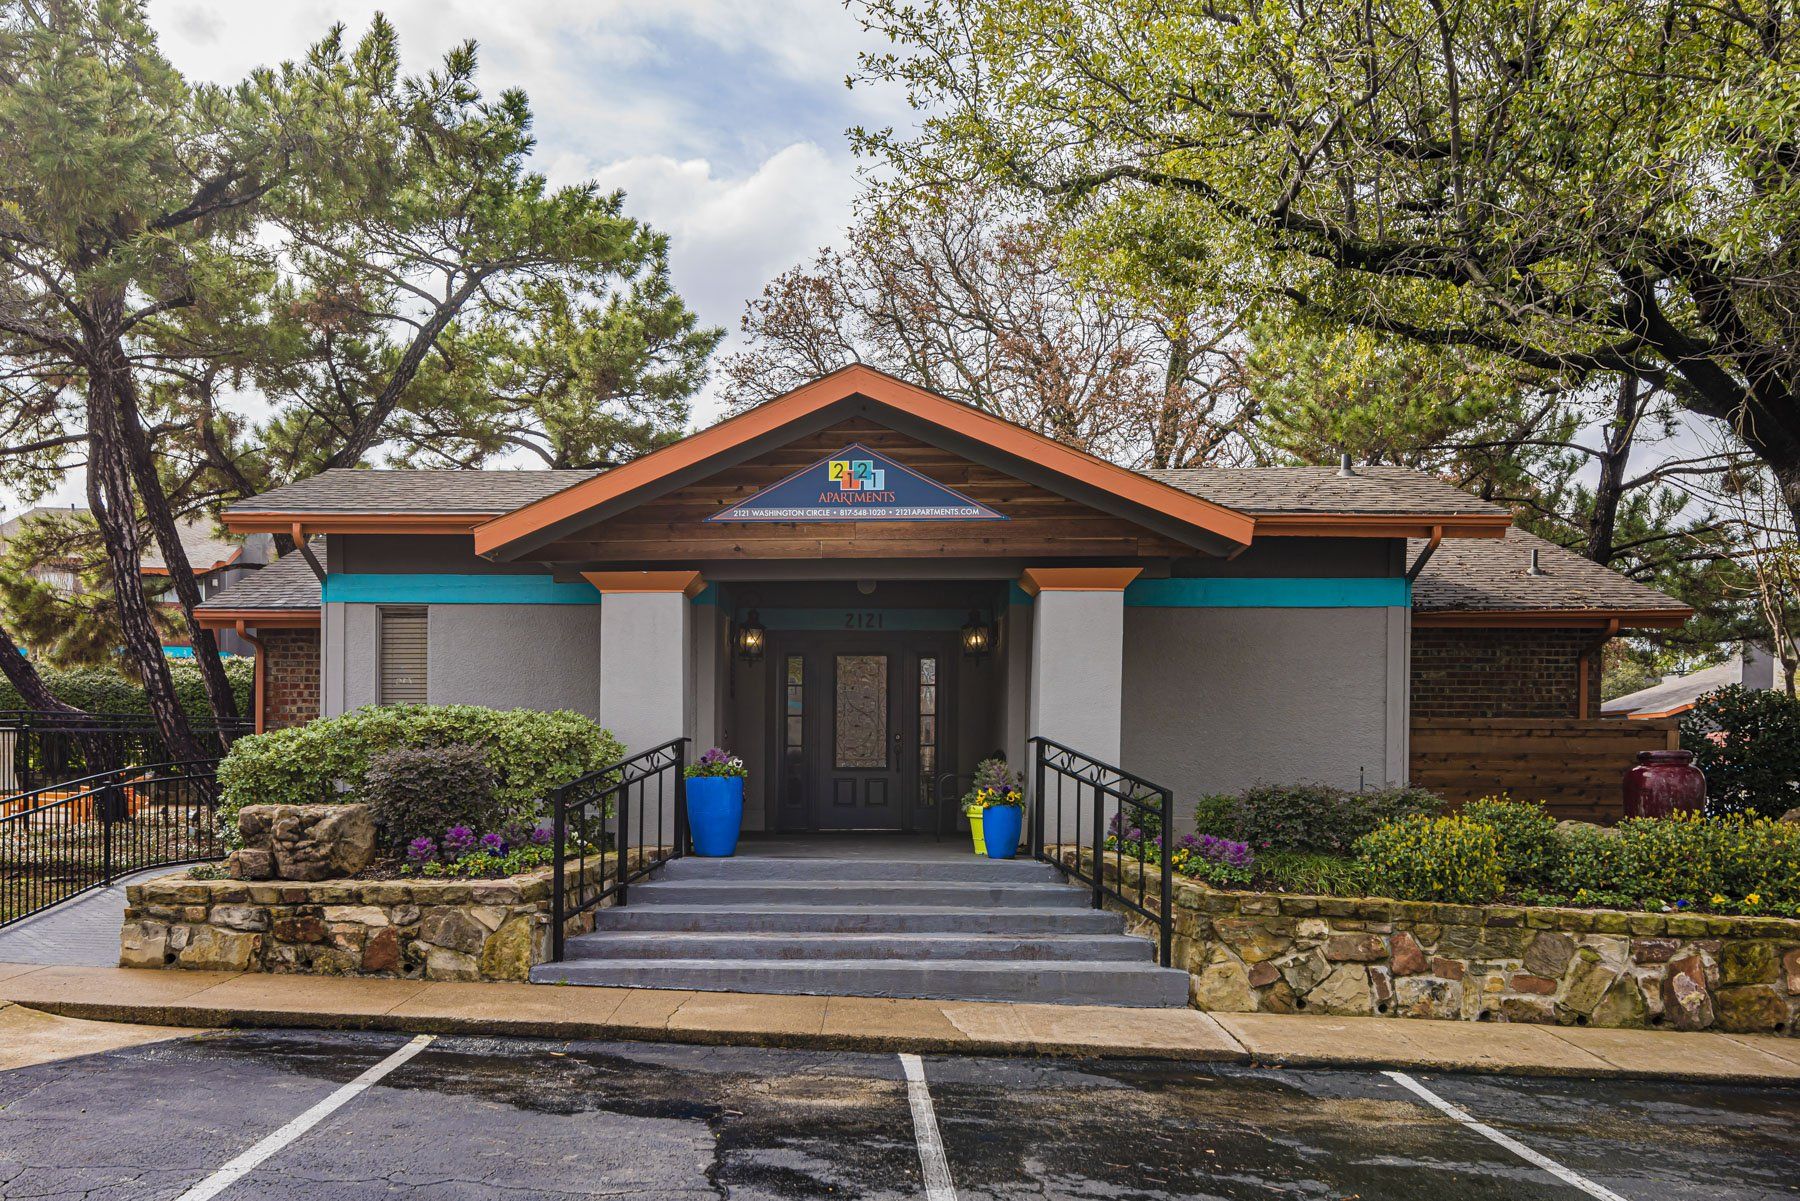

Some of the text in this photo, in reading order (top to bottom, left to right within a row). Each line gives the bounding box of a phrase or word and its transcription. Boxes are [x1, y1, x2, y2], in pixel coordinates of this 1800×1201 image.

[818, 491, 896, 505] APARTMENTS
[733, 508, 980, 517] 2121 WASHINGTON CIRCLE 817-548-1020 2121APARTMENTS.COM
[846, 613, 882, 628] 2121
